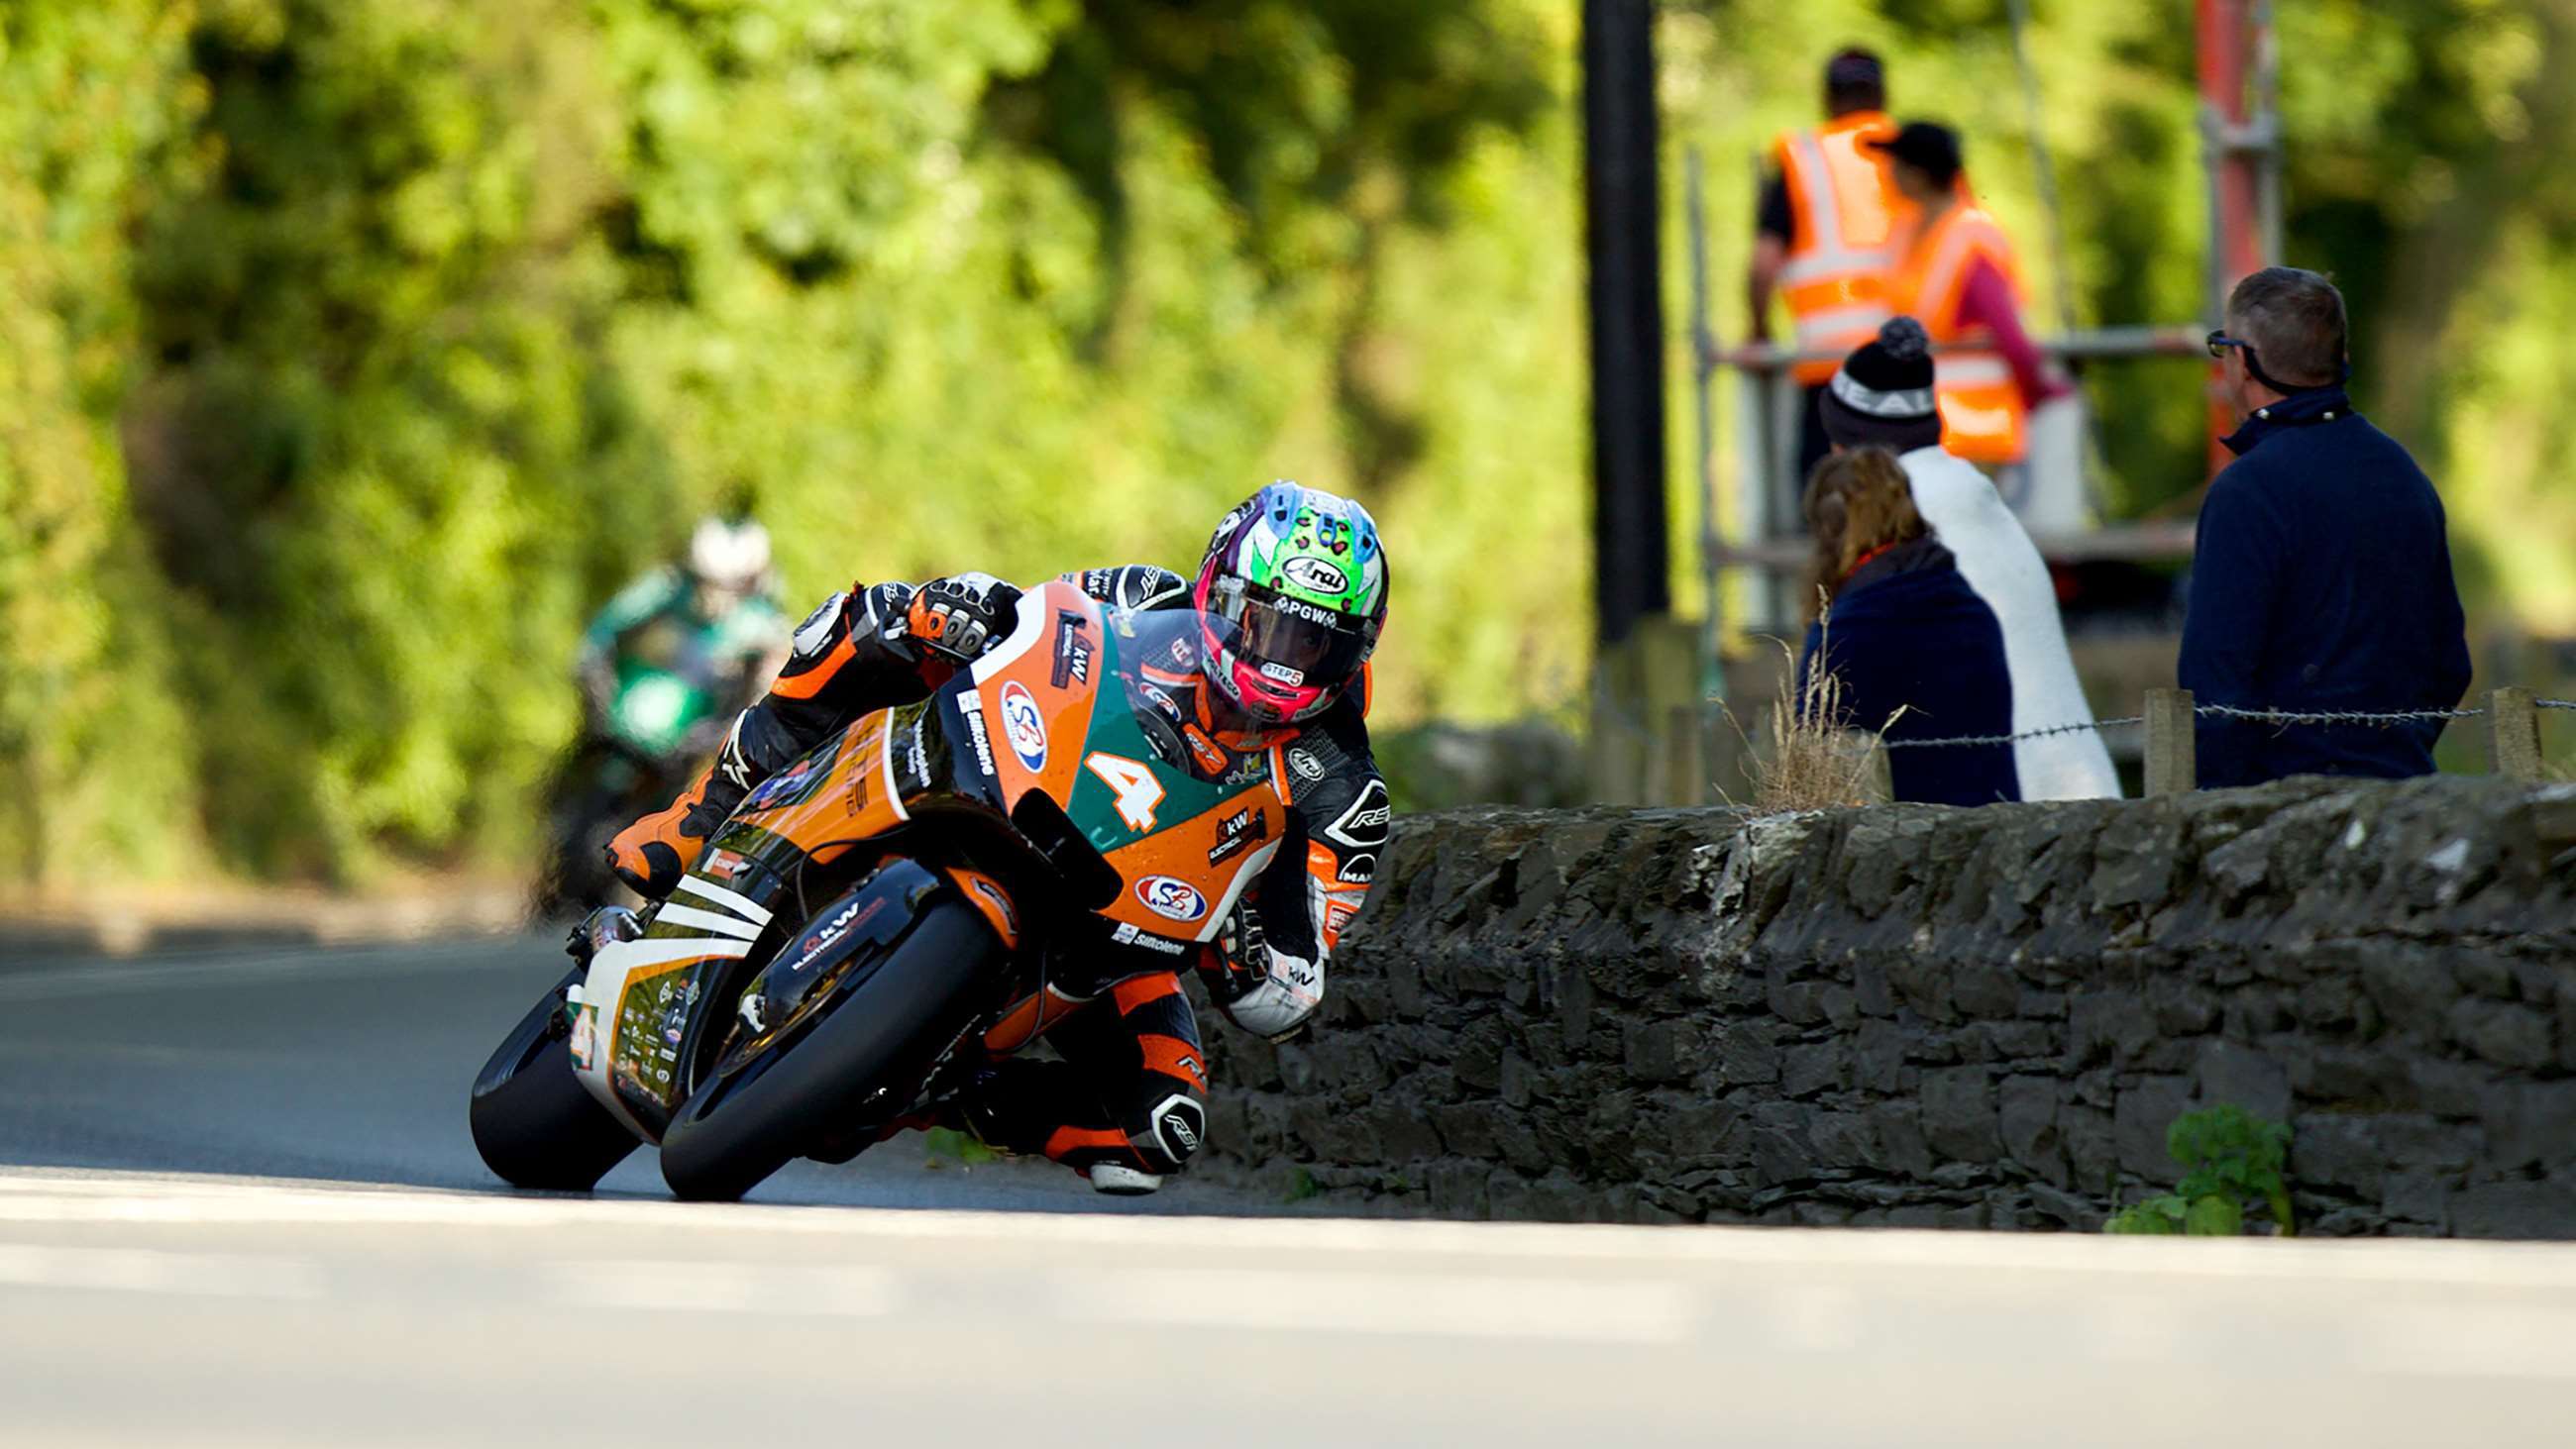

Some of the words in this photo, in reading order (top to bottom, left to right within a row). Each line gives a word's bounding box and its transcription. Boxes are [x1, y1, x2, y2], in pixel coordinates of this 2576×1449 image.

[1285, 561, 1342, 588] Arai
[1288, 601, 1327, 623] PGW
[1085, 751, 1165, 833] 4
[1228, 811, 1247, 836] kW
[819, 902, 859, 939] kW
